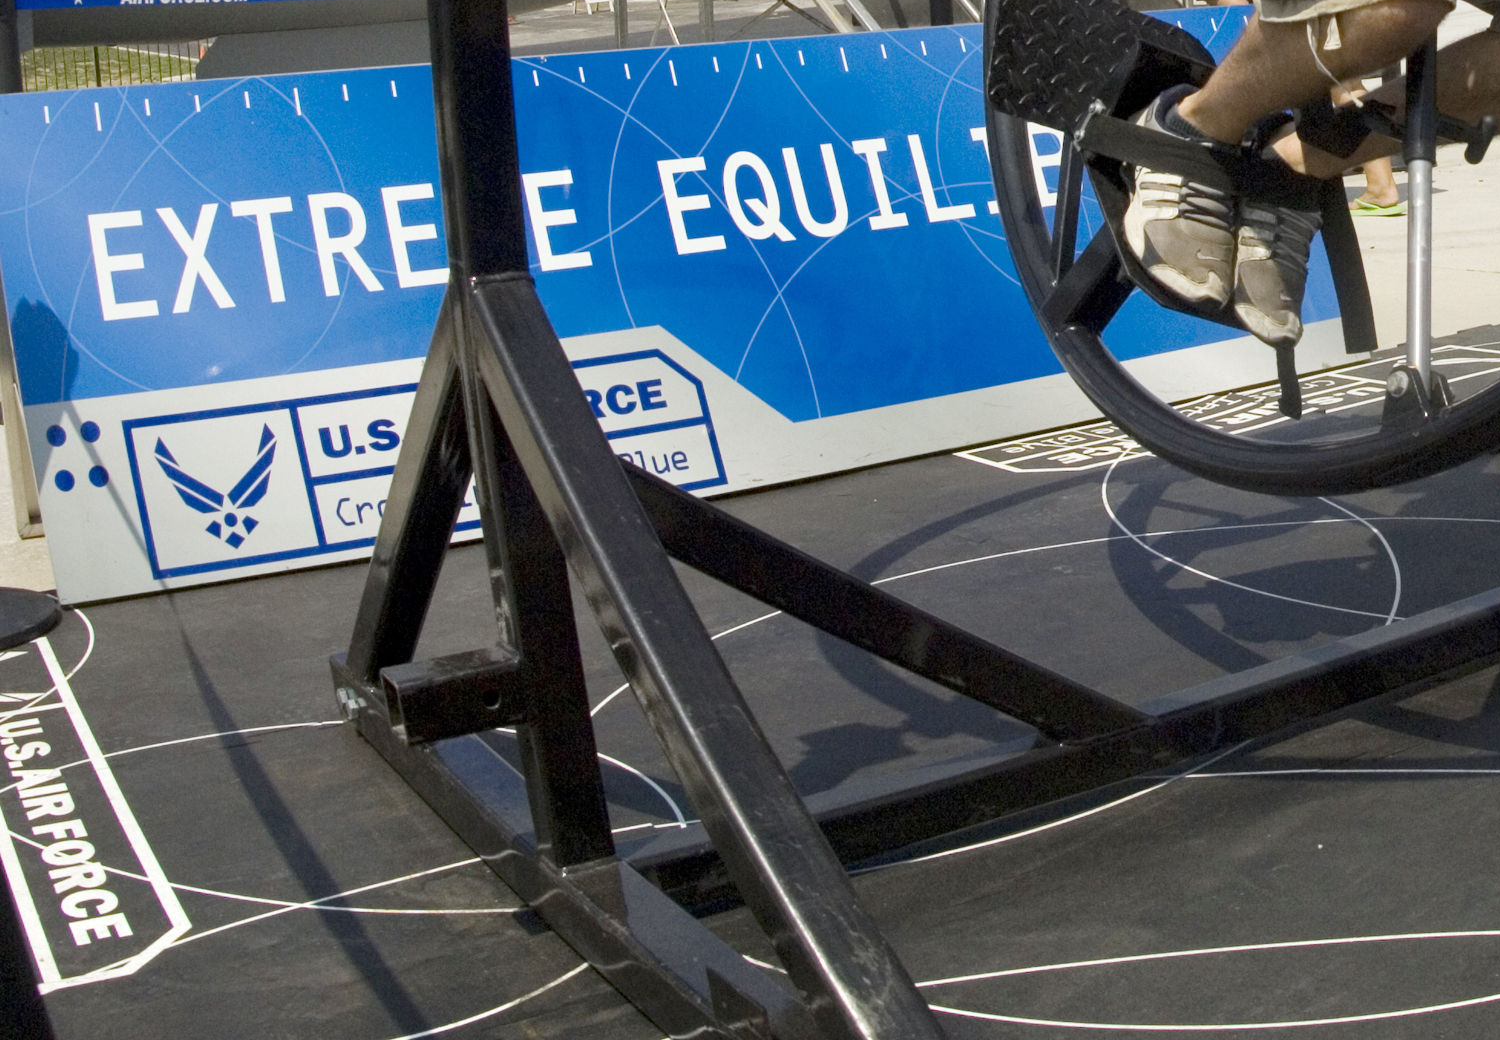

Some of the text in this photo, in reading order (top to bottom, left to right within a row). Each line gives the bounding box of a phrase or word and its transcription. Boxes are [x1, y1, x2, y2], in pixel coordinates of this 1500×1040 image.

[87, 121, 1066, 322] EXTREE EQUILB
[318, 418, 401, 459] U.S
[336, 496, 387, 527] Cro
[11, 769, 75, 821] AIR
[32, 819, 134, 947] FORCE
